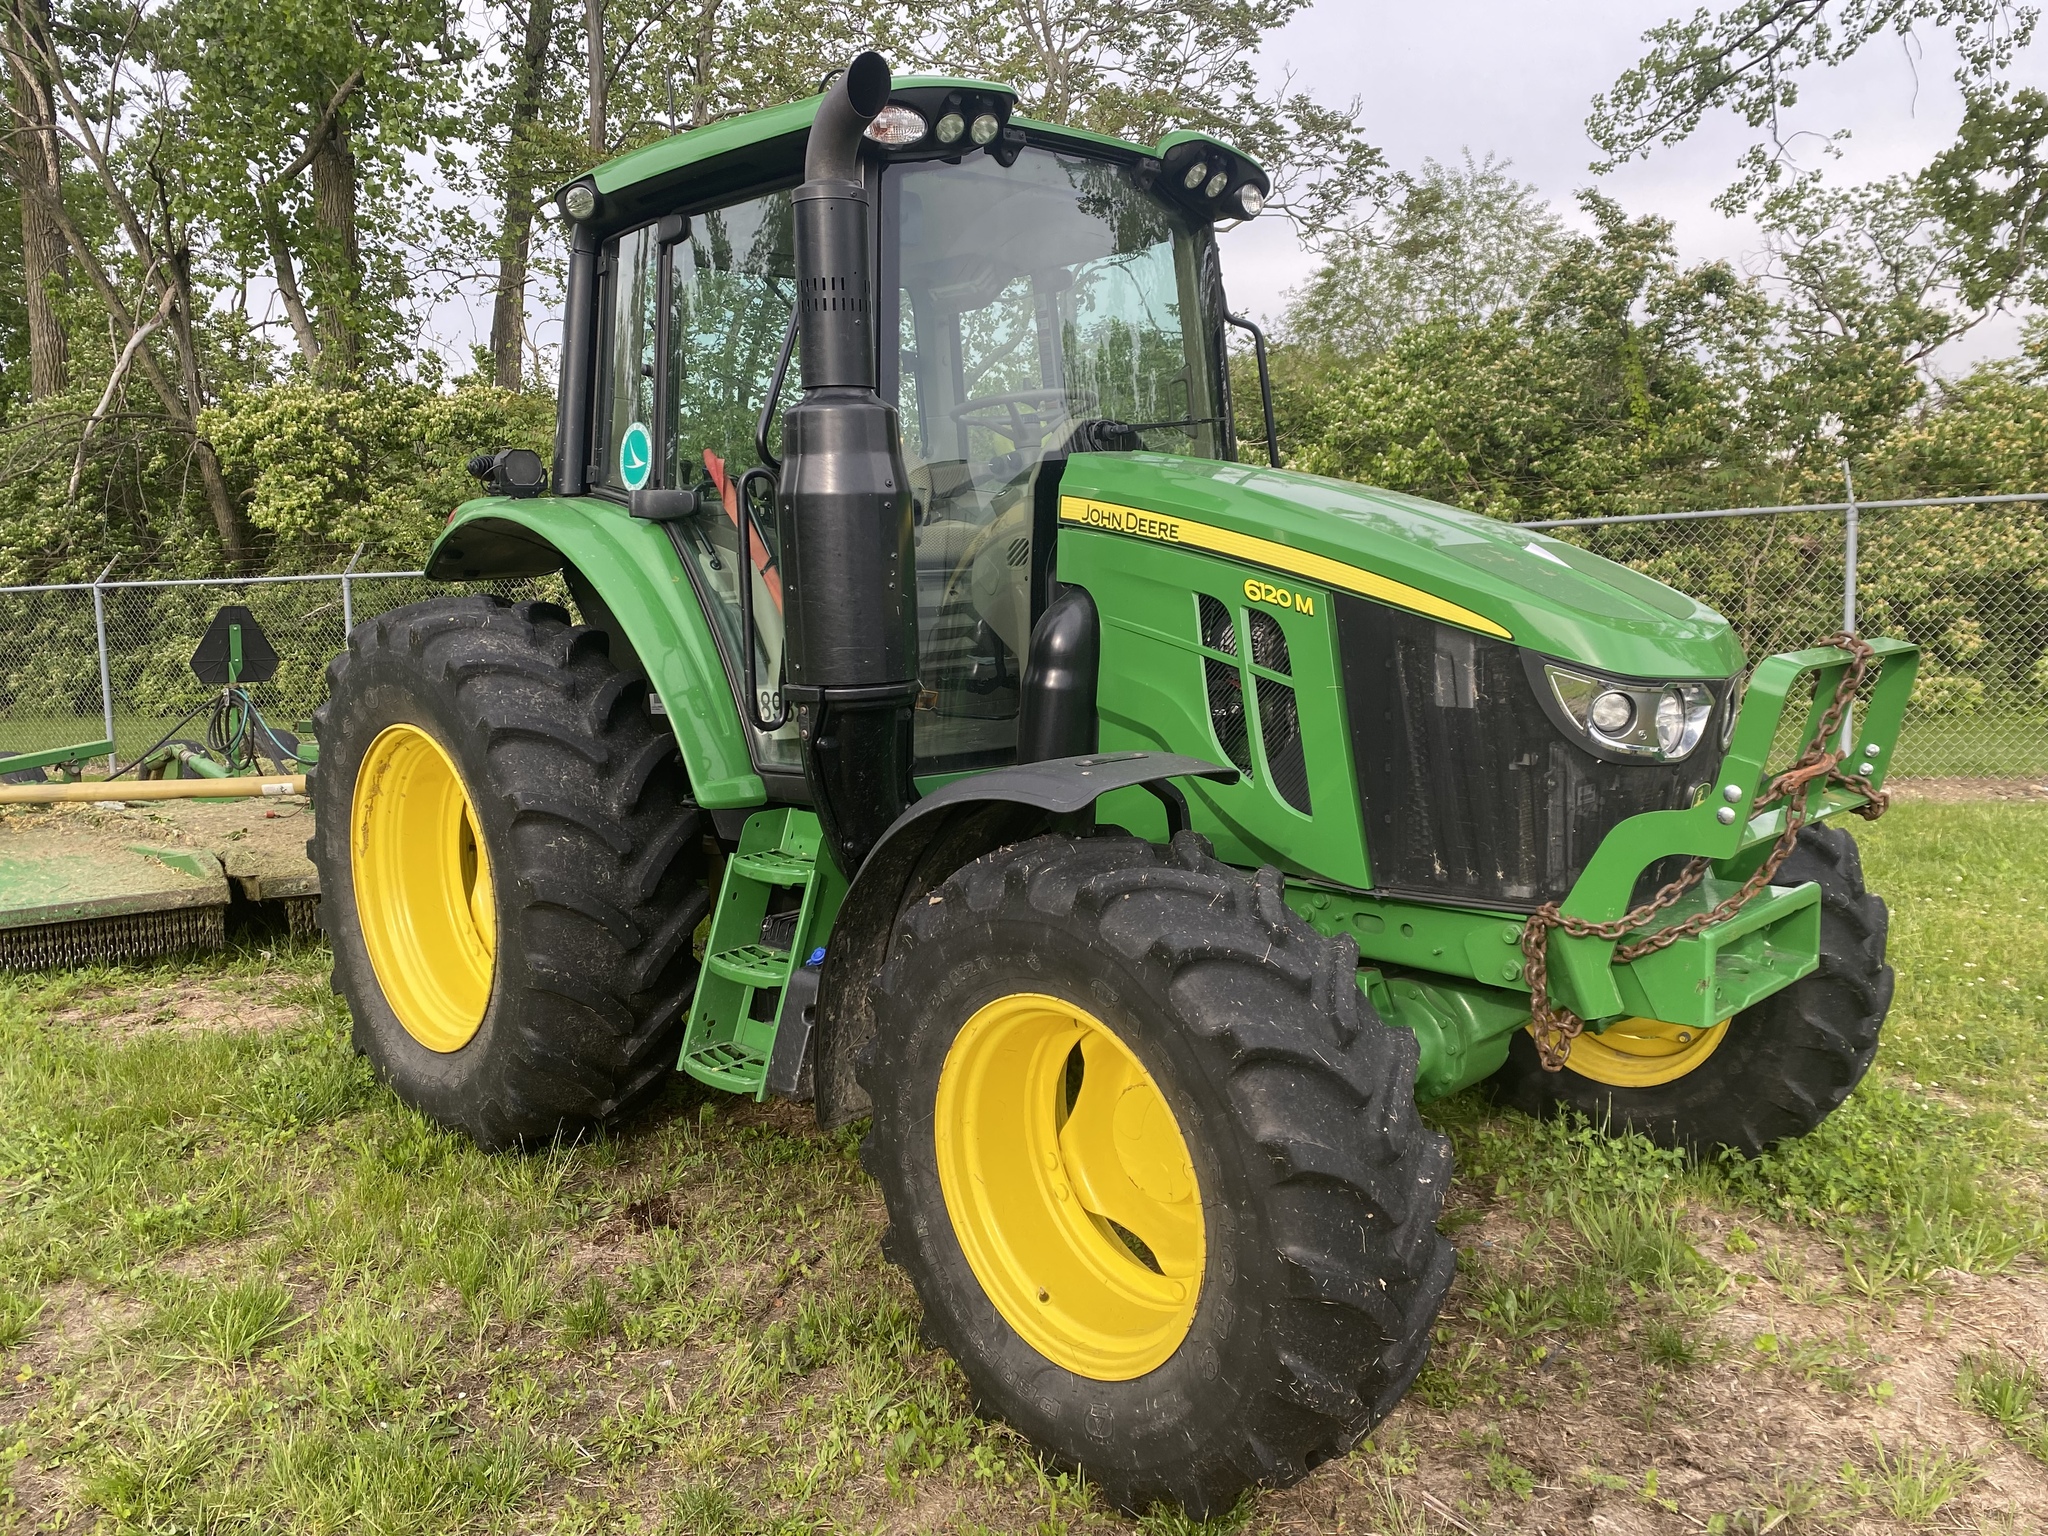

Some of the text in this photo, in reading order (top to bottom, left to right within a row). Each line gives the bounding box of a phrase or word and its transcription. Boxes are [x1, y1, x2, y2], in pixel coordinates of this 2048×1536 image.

[1081, 503, 1180, 541] JOHN DEERE
[1242, 578, 1292, 609] 6120
